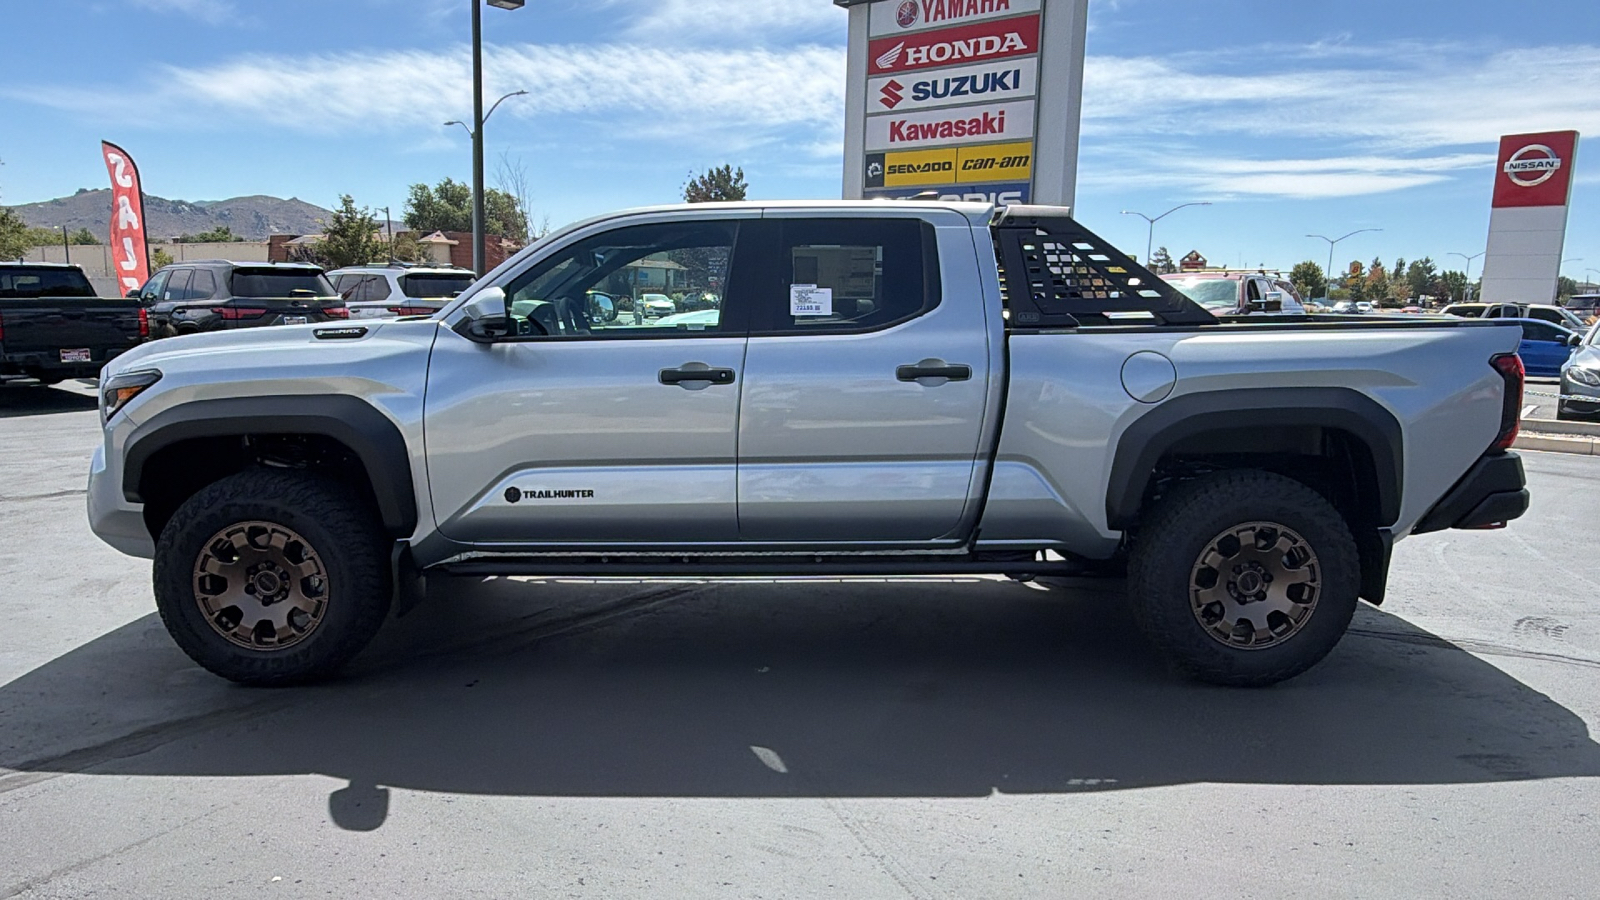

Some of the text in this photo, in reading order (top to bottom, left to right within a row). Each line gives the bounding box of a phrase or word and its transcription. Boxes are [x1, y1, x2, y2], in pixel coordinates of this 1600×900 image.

[905, 32, 1027, 66] HONDA
[911, 69, 1021, 101] SUZUKI
[889, 110, 1005, 143] Kawasaki
[1509, 161, 1554, 170] NISSAN
[523, 489, 594, 499] TRAILHUNTER
